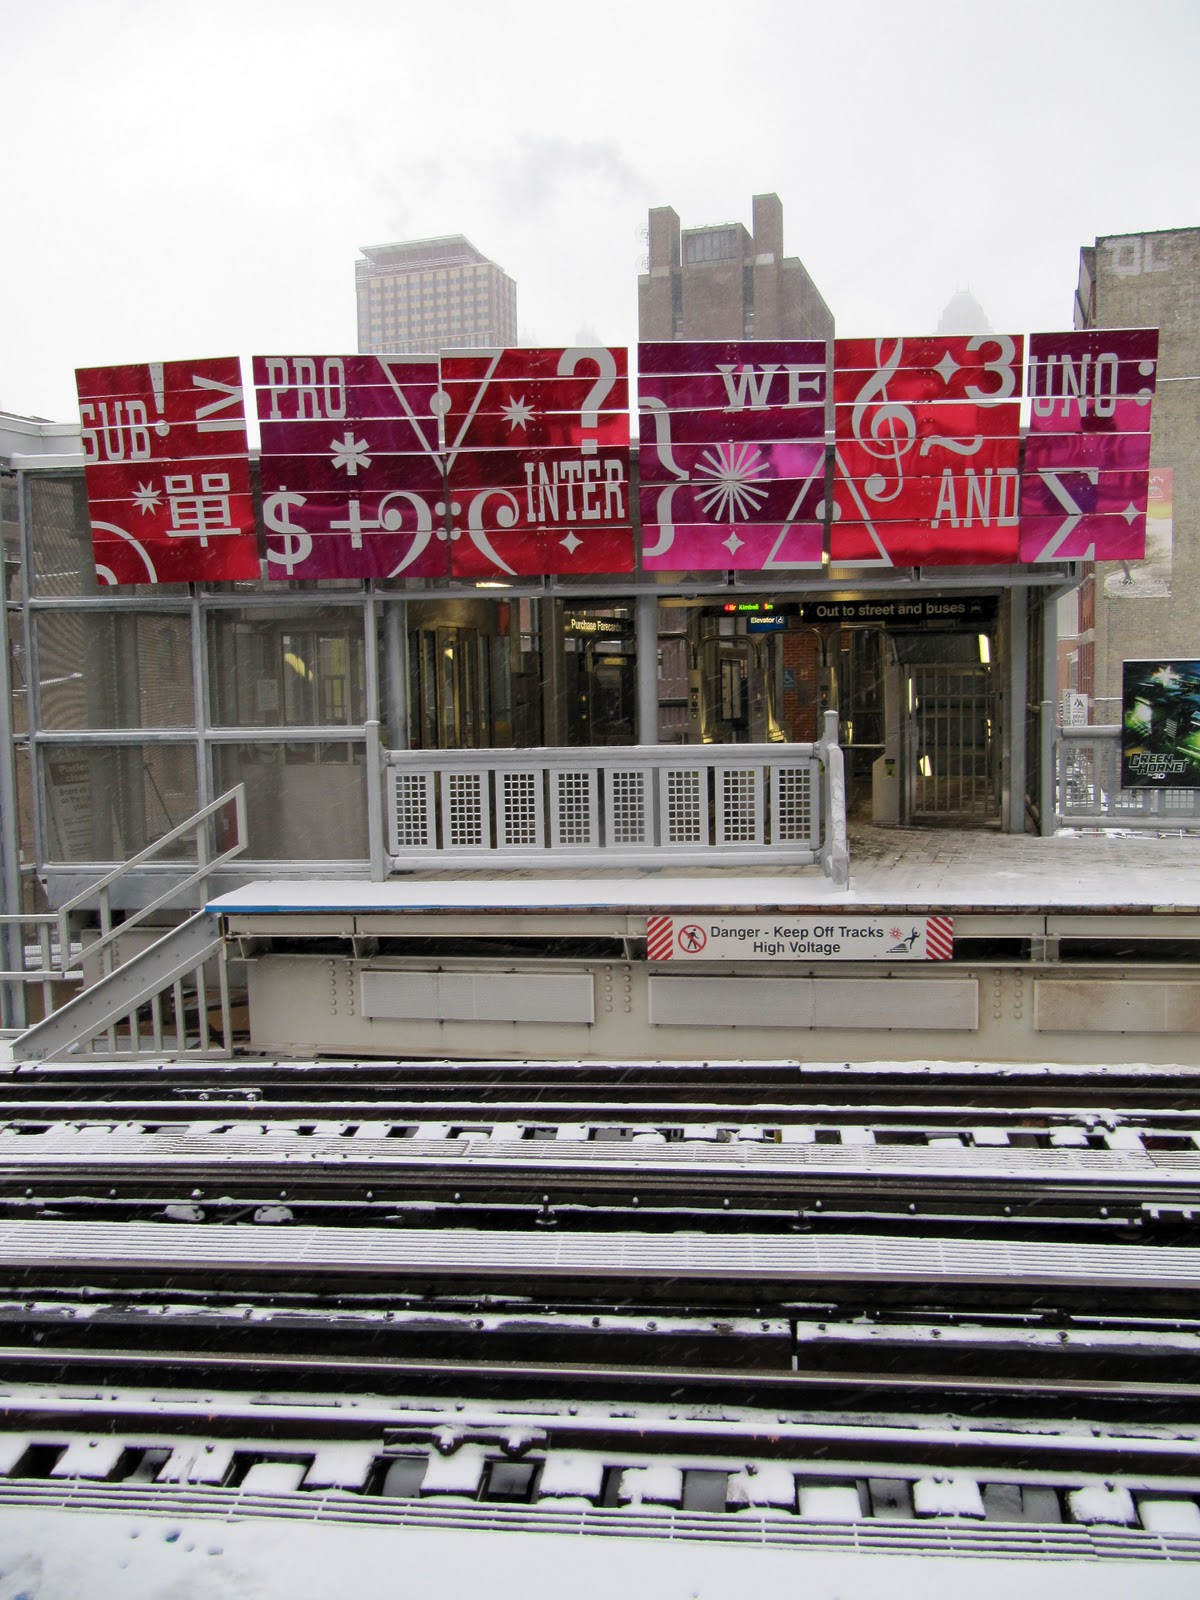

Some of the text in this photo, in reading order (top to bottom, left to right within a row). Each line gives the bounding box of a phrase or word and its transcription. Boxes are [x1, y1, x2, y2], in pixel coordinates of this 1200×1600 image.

[265, 358, 347, 419] PRO
[715, 364, 826, 413] WE
[1029, 353, 1119, 418] UNO
[80, 400, 151, 462] SUB
[524, 460, 625, 522] INTER
[931, 468, 1019, 529] AND
[571, 618, 623, 632] Purchase Farecards
[816, 602, 965, 617] Out to street and buses
[1129, 752, 1174, 768] GREEN
[1131, 760, 1189, 775] HORNET
[710, 926, 761, 941] Danger
[773, 926, 809, 941] Keep
[813, 926, 834, 938] Off
[838, 925, 884, 938] Tracks
[753, 941, 841, 954] High Voltage
